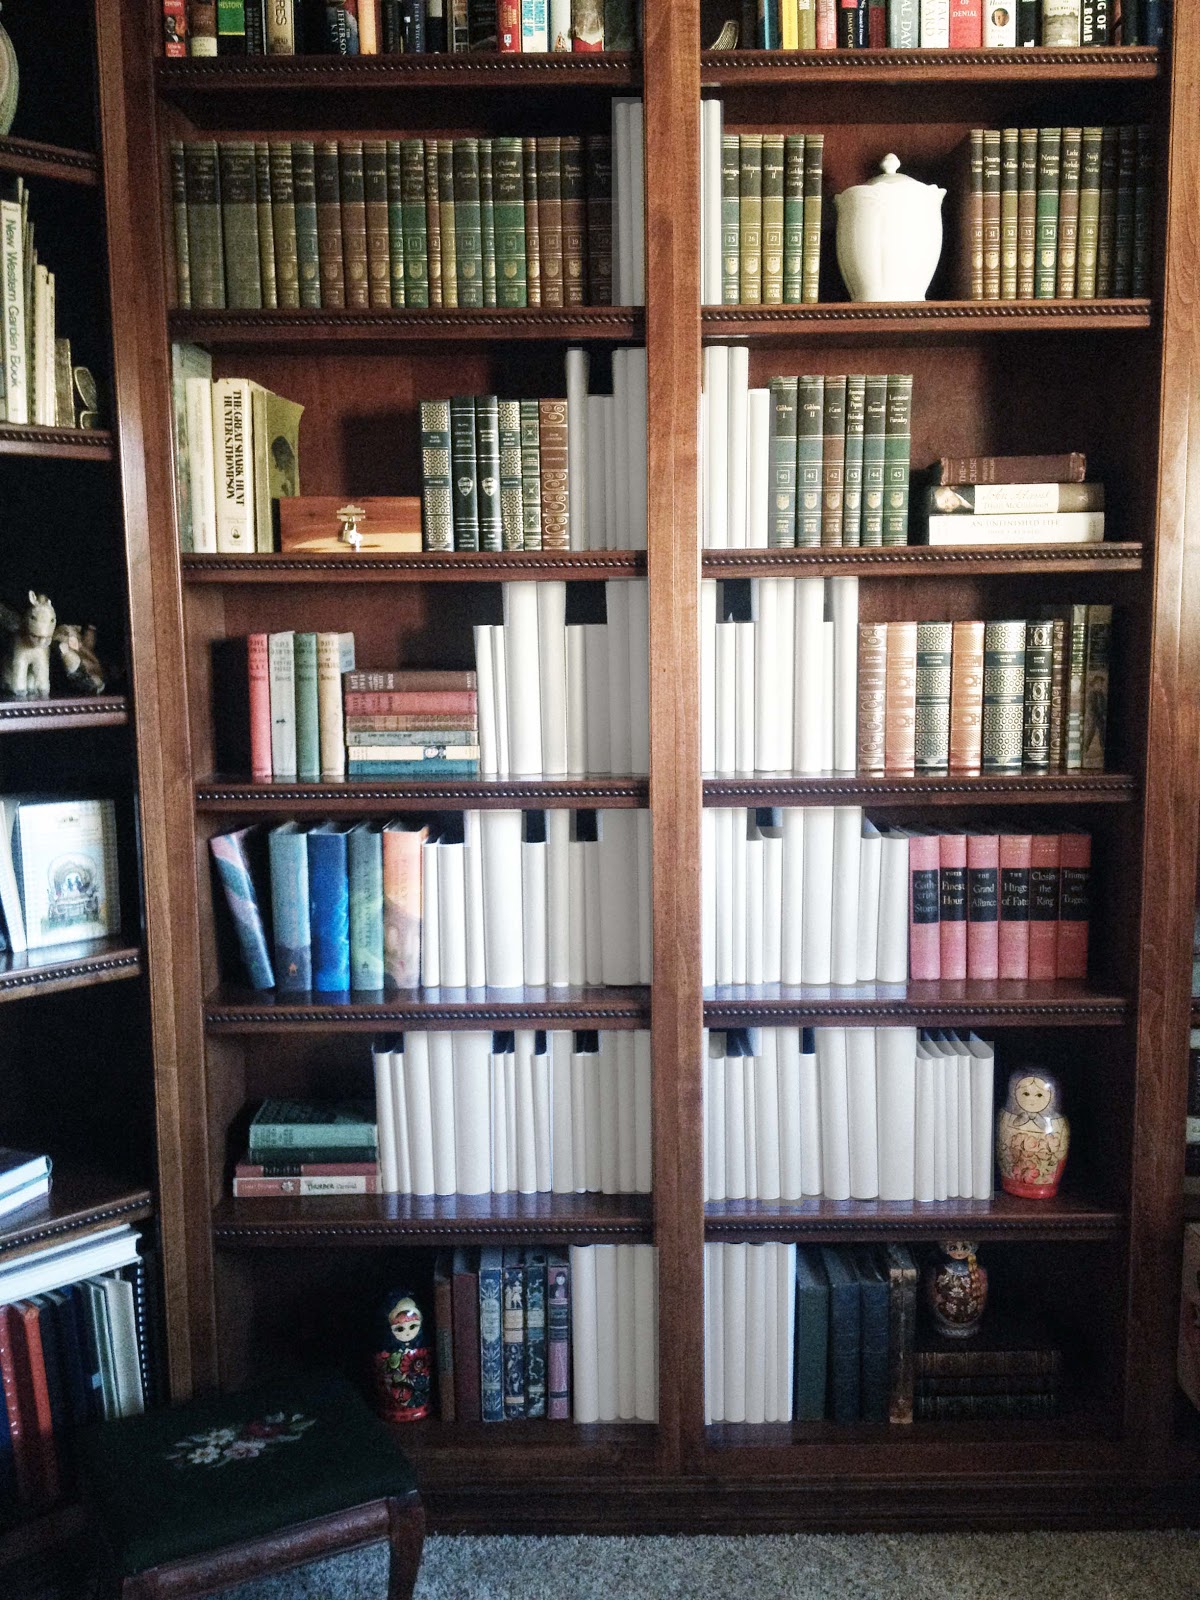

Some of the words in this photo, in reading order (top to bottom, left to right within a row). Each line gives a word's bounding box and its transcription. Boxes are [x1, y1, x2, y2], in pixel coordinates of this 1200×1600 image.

[1084, 8, 1093, 41] BOMB
[1097, 15, 1107, 29] OF
[337, 10, 347, 55] JEFFERSON
[901, 21, 912, 49] DAY
[6, 219, 17, 248] New
[7, 251, 18, 302] Western
[8, 306, 20, 351] Garden
[10, 355, 21, 388] Book
[969, 458, 977, 483] CRISIS
[942, 881, 966, 891] Finest
[972, 883, 995, 893] Grand
[1004, 882, 1028, 894] Hinge
[943, 895, 965, 905] Hour
[971, 898, 997, 908] Alliance
[1001, 896, 1012, 906] of
[1036, 896, 1056, 908] Ring
